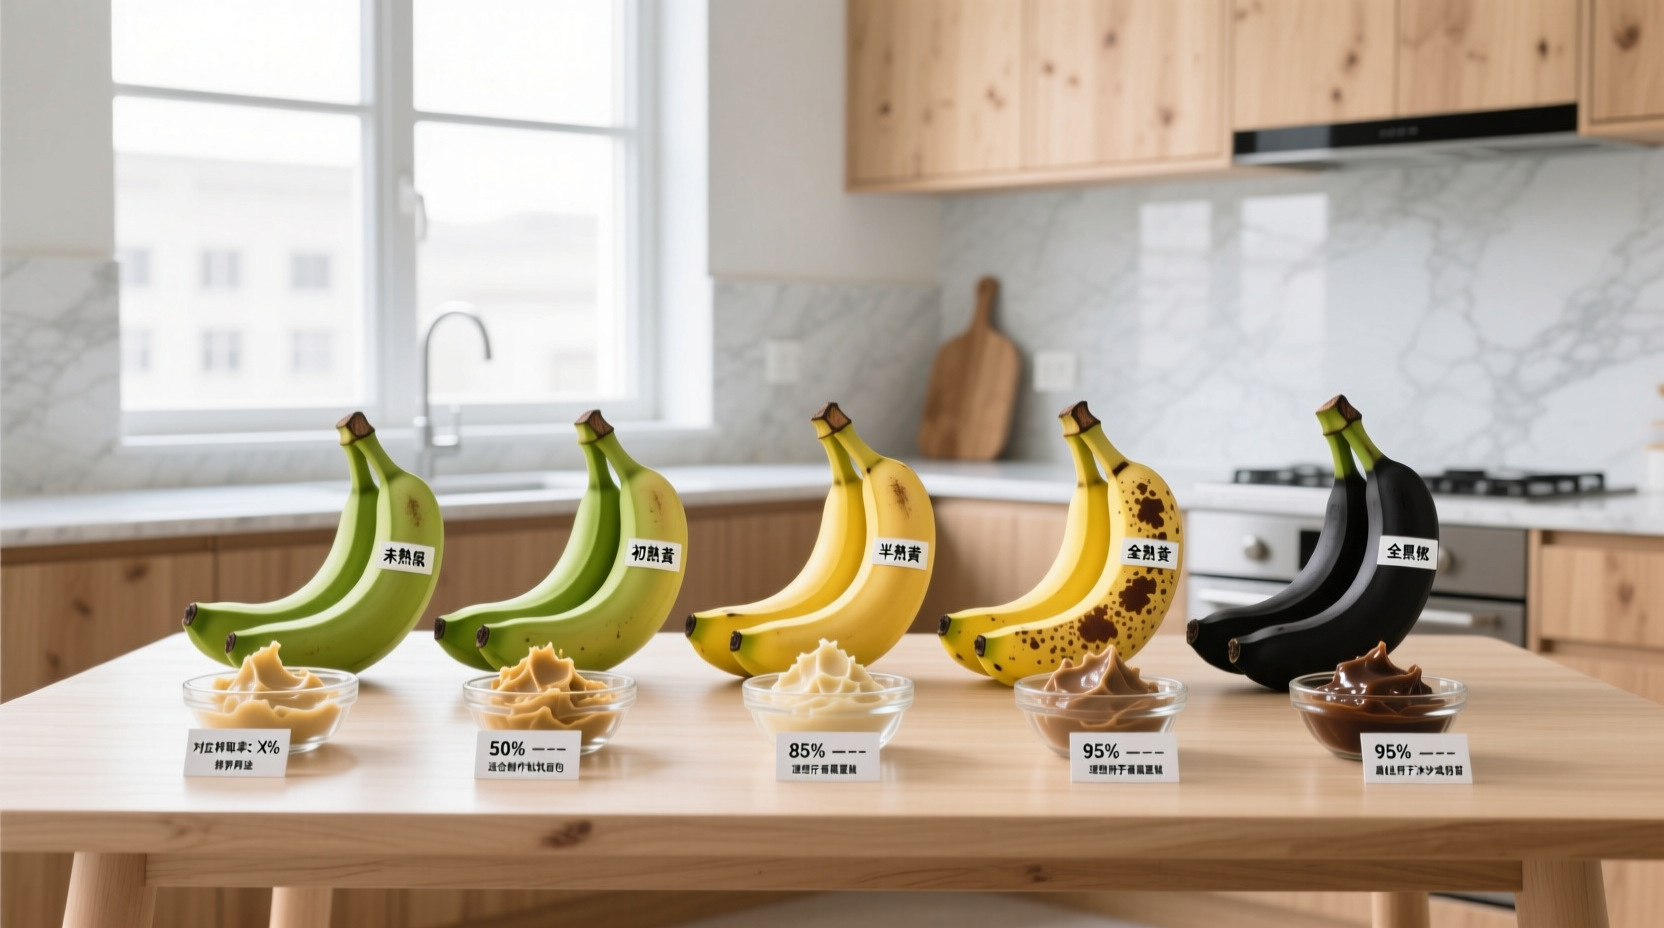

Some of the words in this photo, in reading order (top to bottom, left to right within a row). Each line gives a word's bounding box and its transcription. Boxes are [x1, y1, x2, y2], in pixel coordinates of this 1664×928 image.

[489, 740, 526, 756] 50%
[788, 742, 826, 758] 85%
[1083, 742, 1120, 759] 95%
[1374, 743, 1412, 759] 95%
